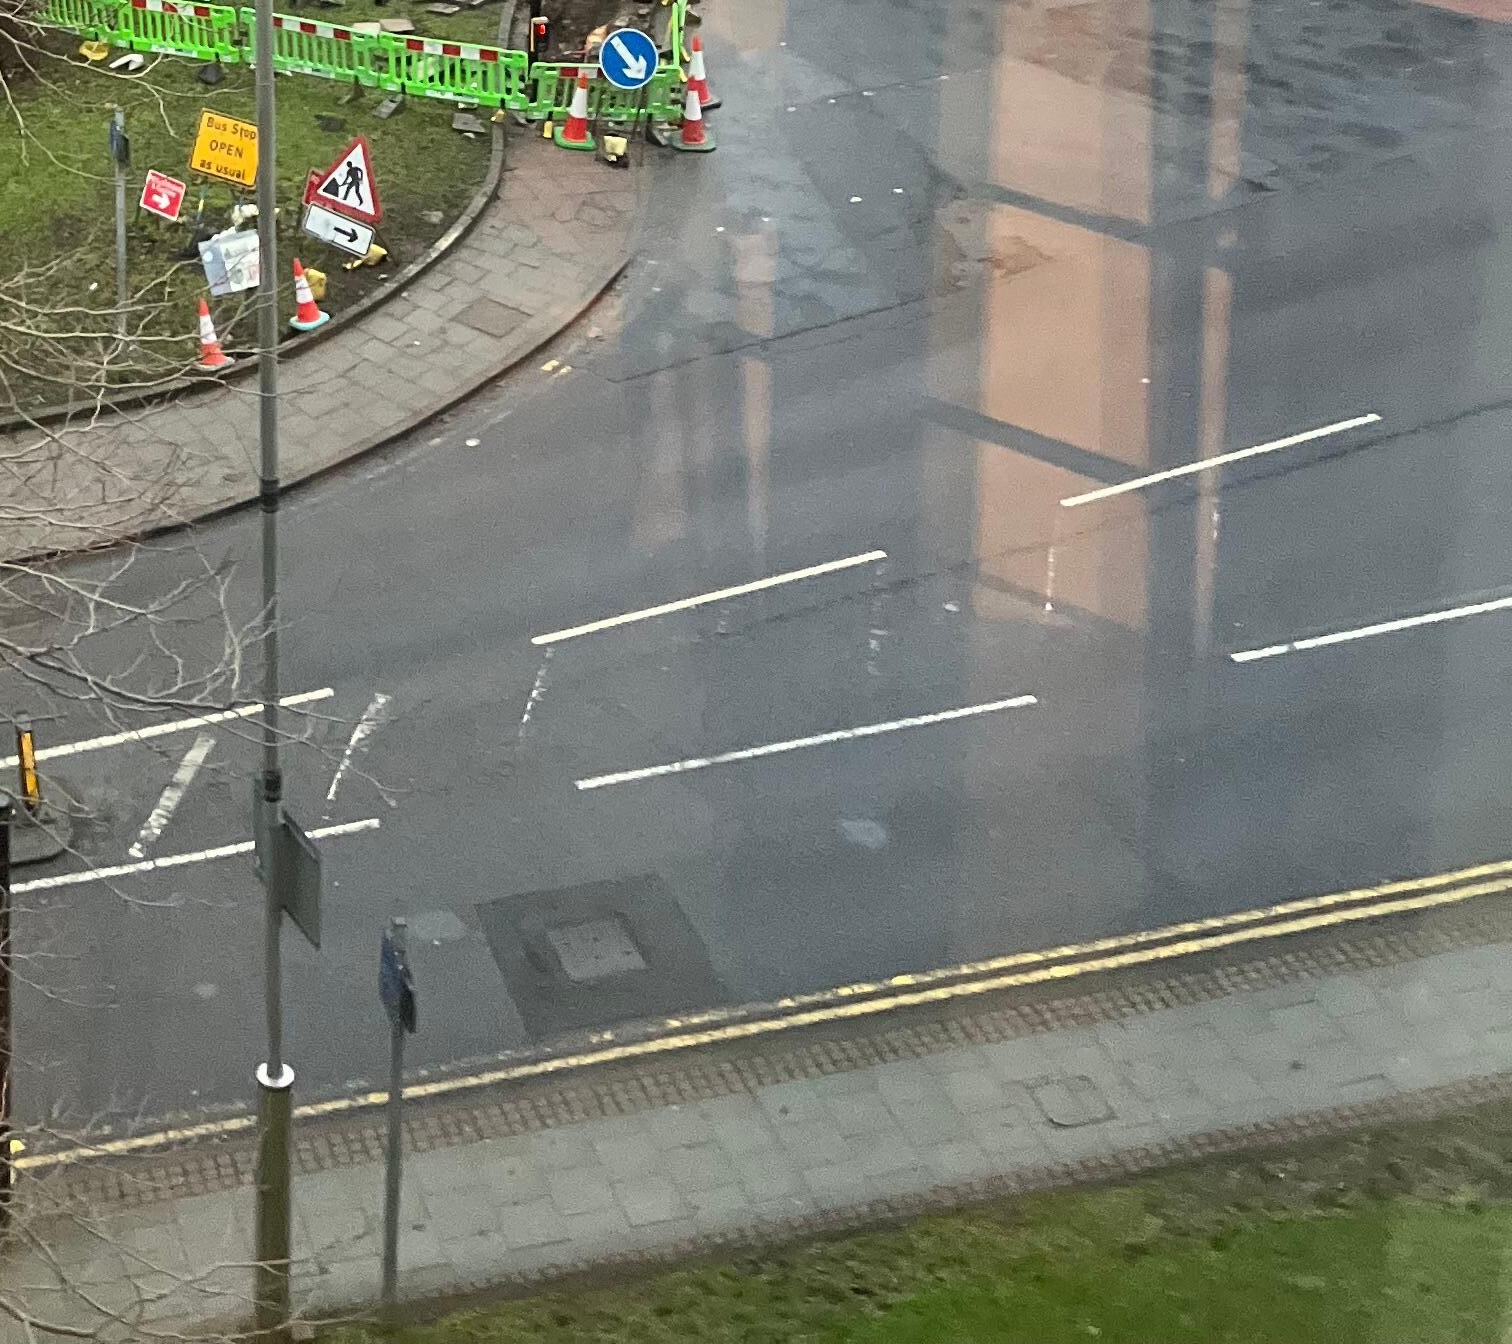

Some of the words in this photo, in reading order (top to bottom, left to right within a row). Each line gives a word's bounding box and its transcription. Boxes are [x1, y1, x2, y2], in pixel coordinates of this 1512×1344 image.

[207, 117, 227, 132] Bus
[231, 123, 256, 140] Stop
[209, 139, 244, 159] OPEN
[199, 159, 212, 170] as
[216, 164, 246, 180] usual
